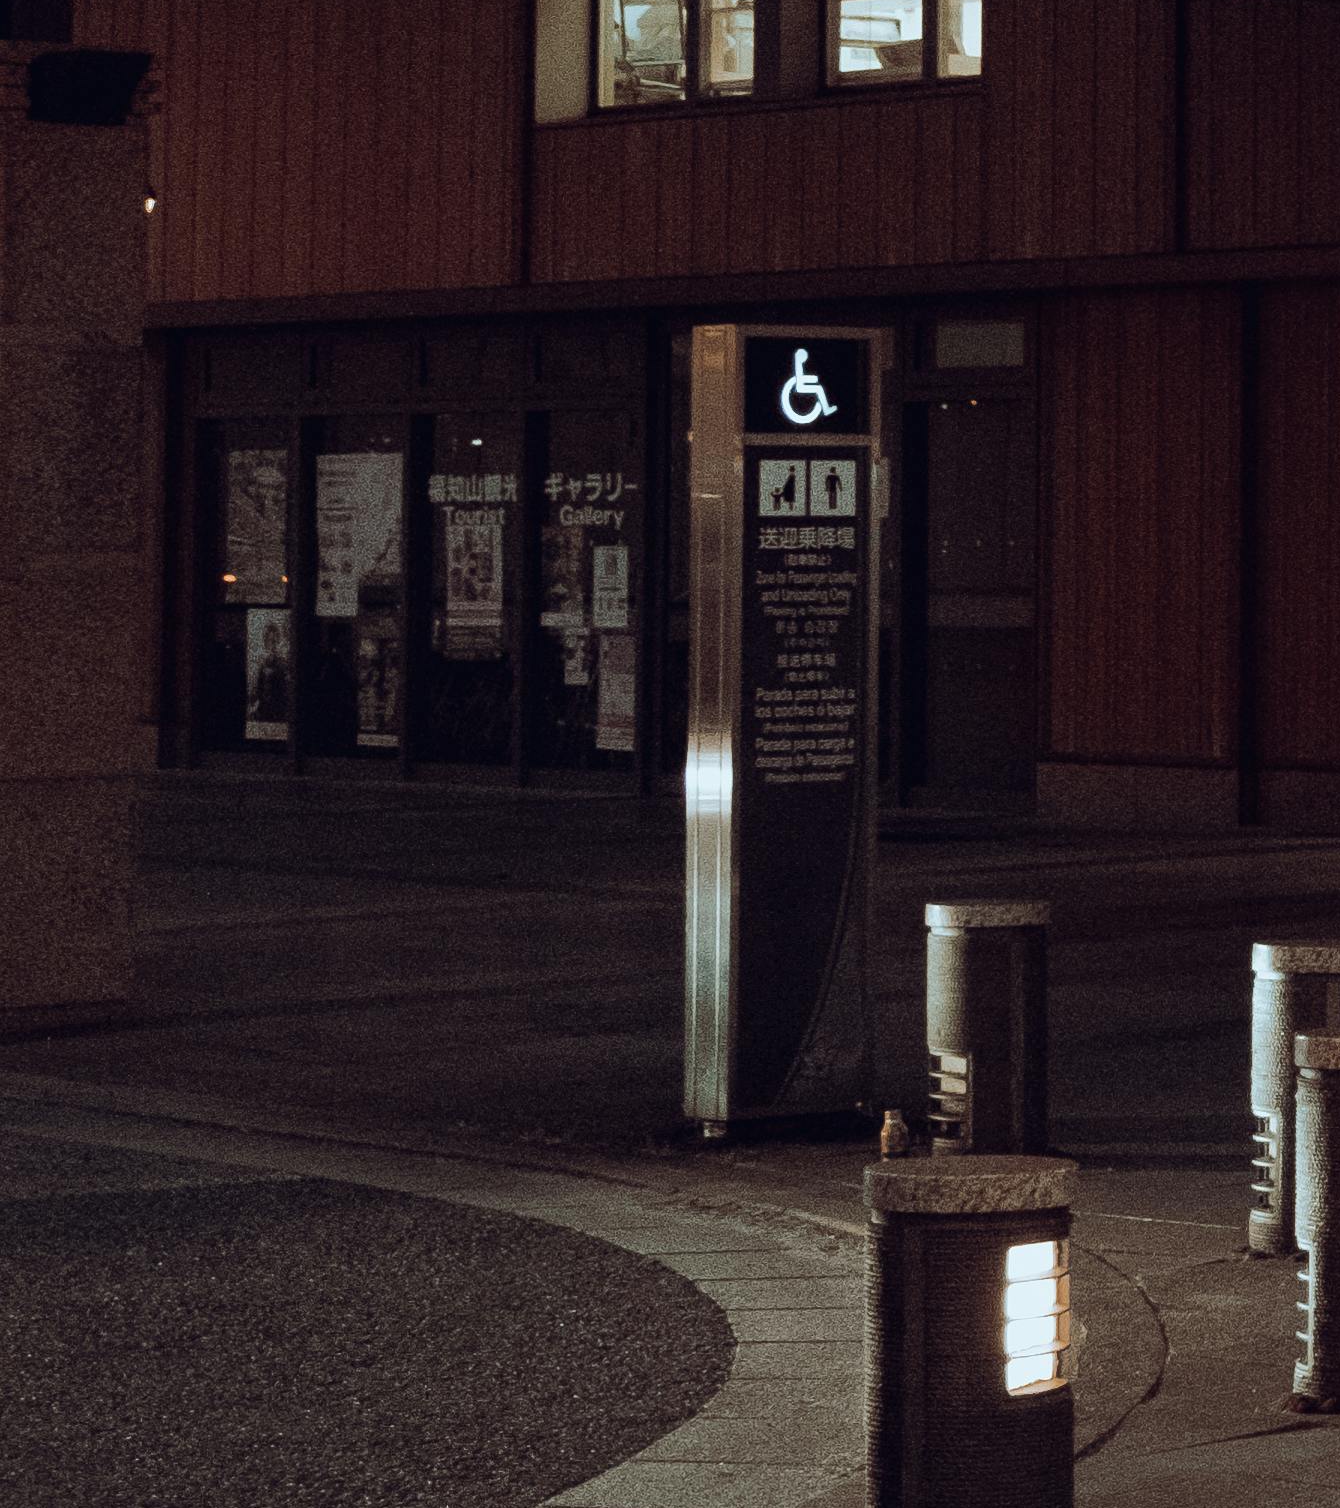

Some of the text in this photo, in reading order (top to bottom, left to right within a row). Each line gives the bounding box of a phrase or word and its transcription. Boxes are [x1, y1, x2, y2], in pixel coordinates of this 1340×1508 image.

[544, 471, 639, 503] ギャラリー
[443, 505, 626, 532] Tourist Gallery
[758, 526, 856, 551] 送迎乗降場
